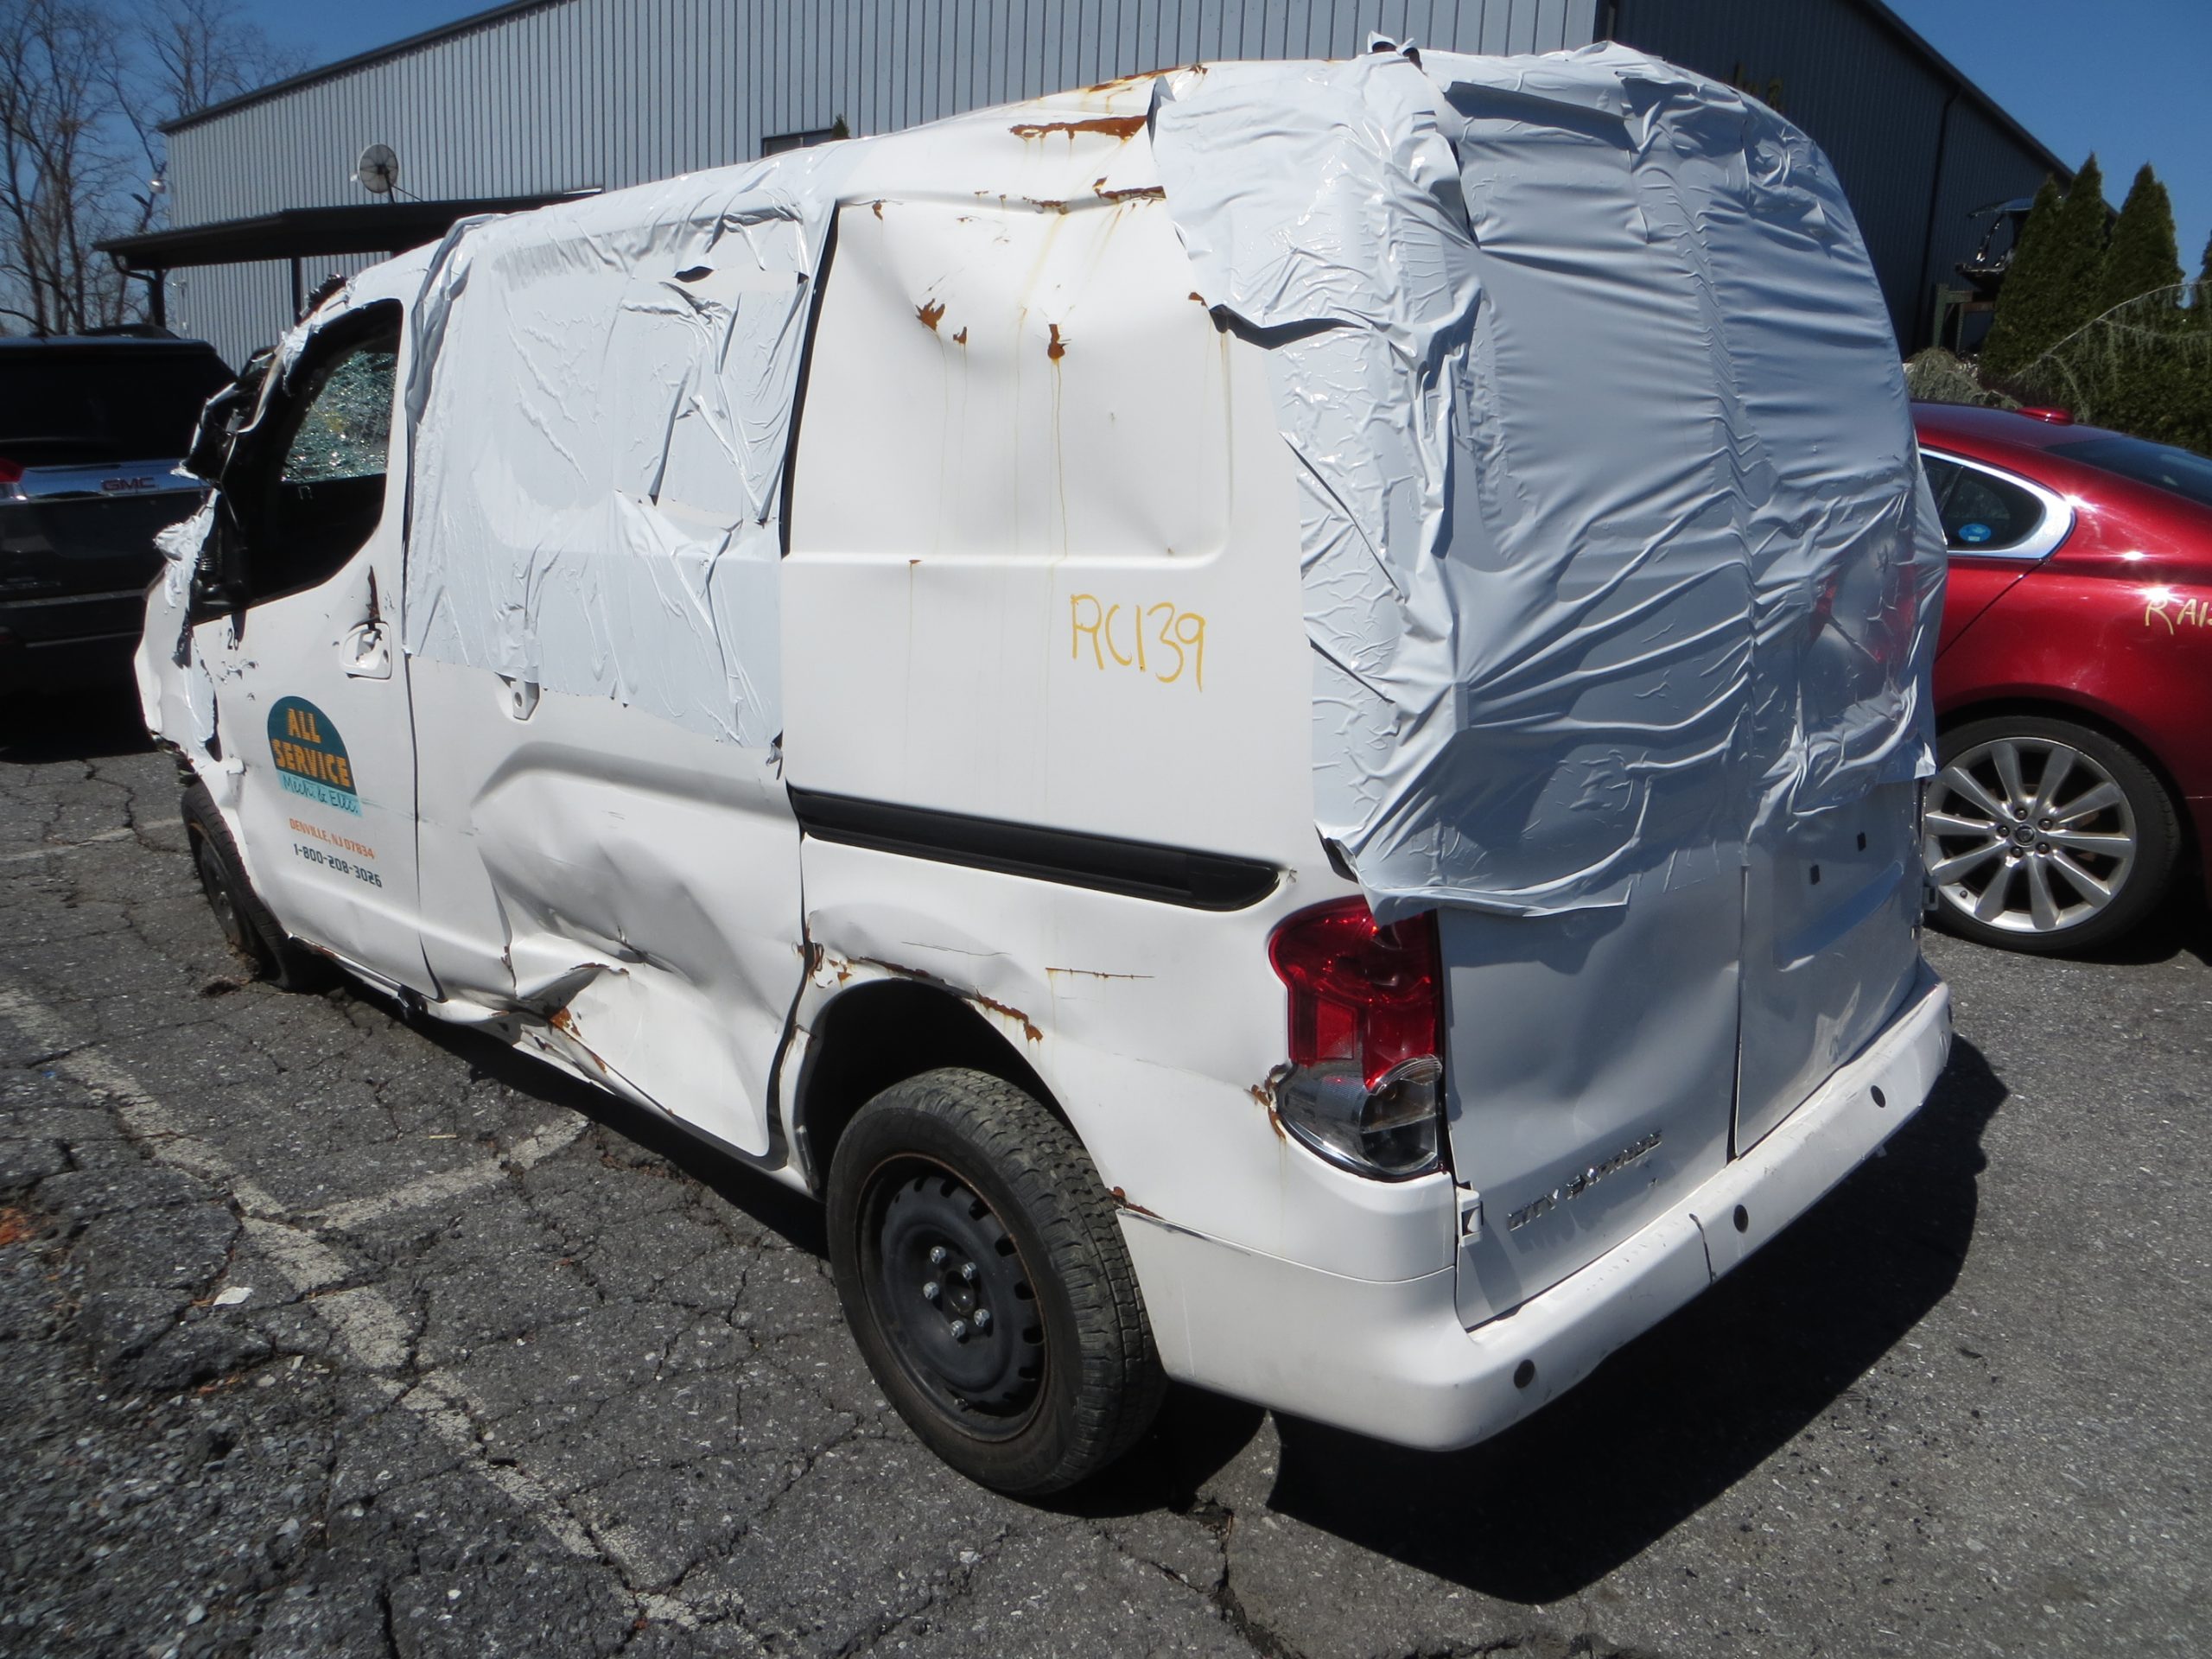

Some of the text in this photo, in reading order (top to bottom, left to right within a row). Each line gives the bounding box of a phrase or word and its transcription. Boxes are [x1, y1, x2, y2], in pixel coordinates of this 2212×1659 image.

[101, 477, 156, 492] GMC
[1070, 594, 1206, 693] RC139
[287, 707, 321, 744] ALL
[271, 738, 352, 788] SERVICE
[317, 786, 327, 804] &
[289, 818, 375, 860] DENVILLE, NJ 07834
[294, 842, 383, 888] 1-800-208-3026
